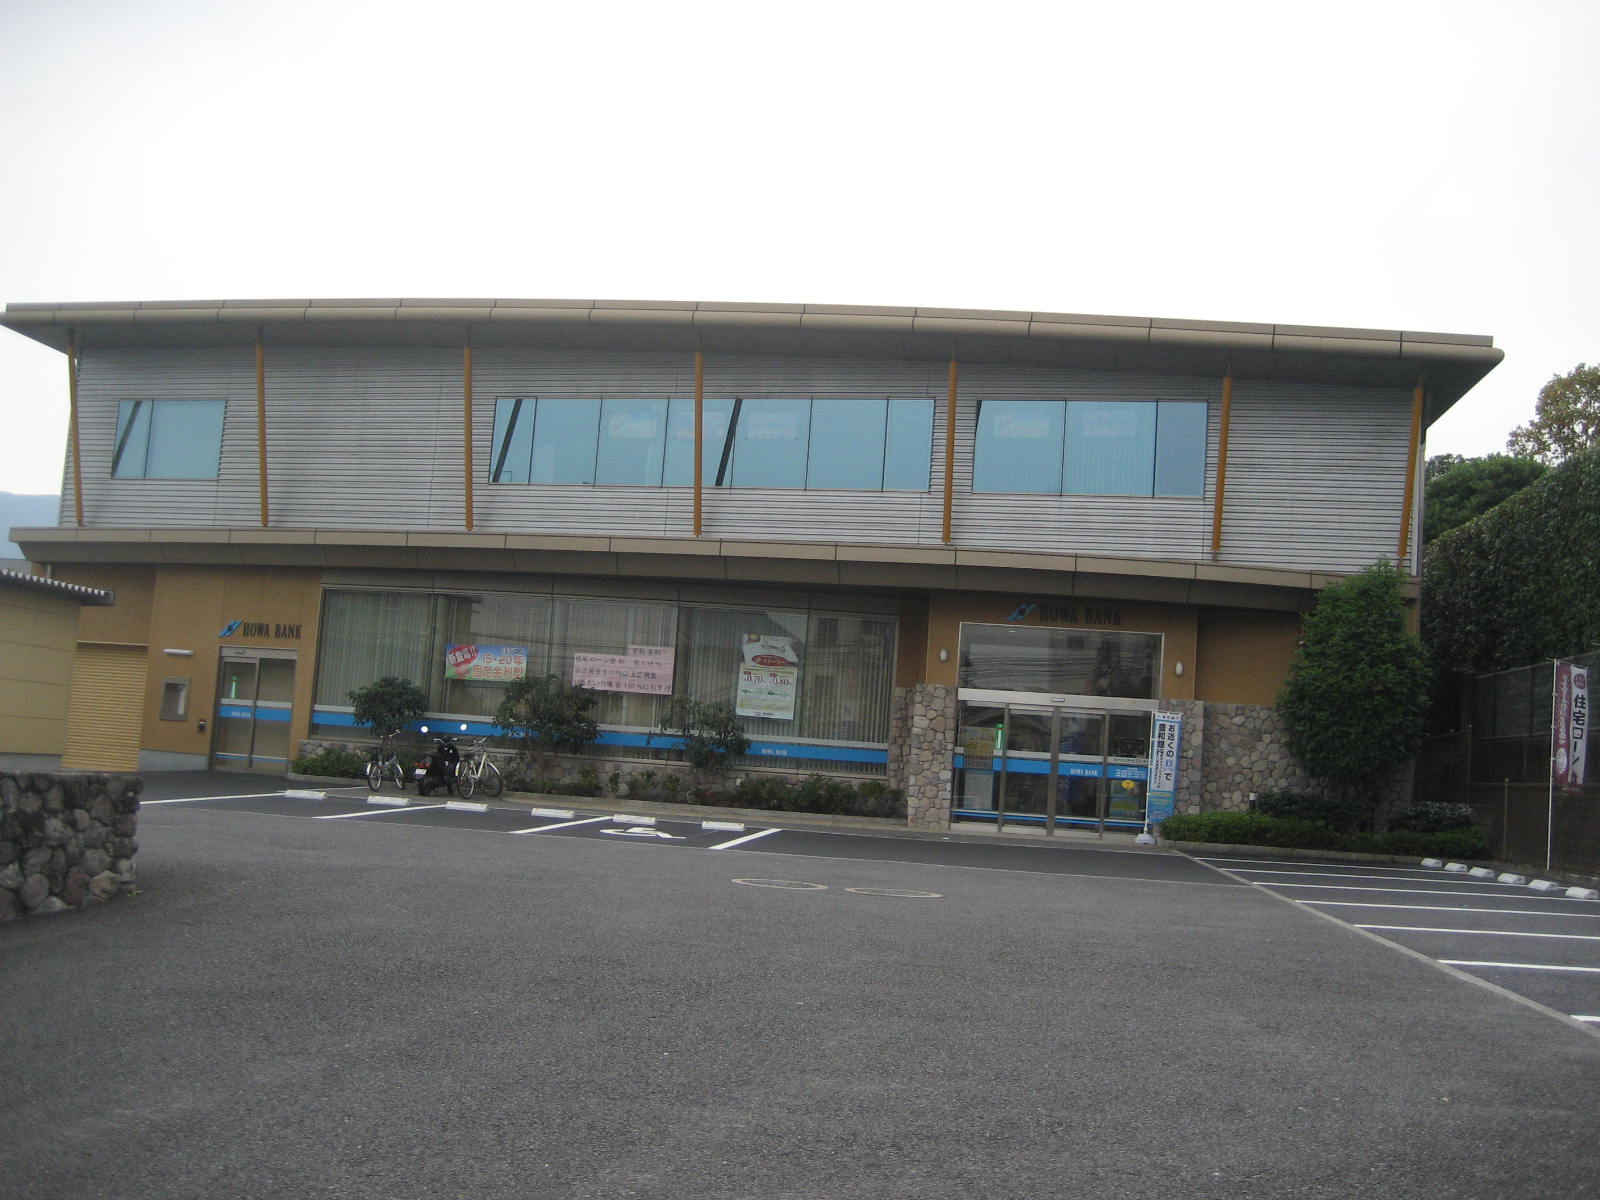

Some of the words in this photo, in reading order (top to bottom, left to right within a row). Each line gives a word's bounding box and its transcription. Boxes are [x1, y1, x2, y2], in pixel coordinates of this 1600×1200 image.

[1085, 607, 1121, 625] BANK
[243, 622, 270, 638] HOWA
[274, 624, 302, 639] BANK
